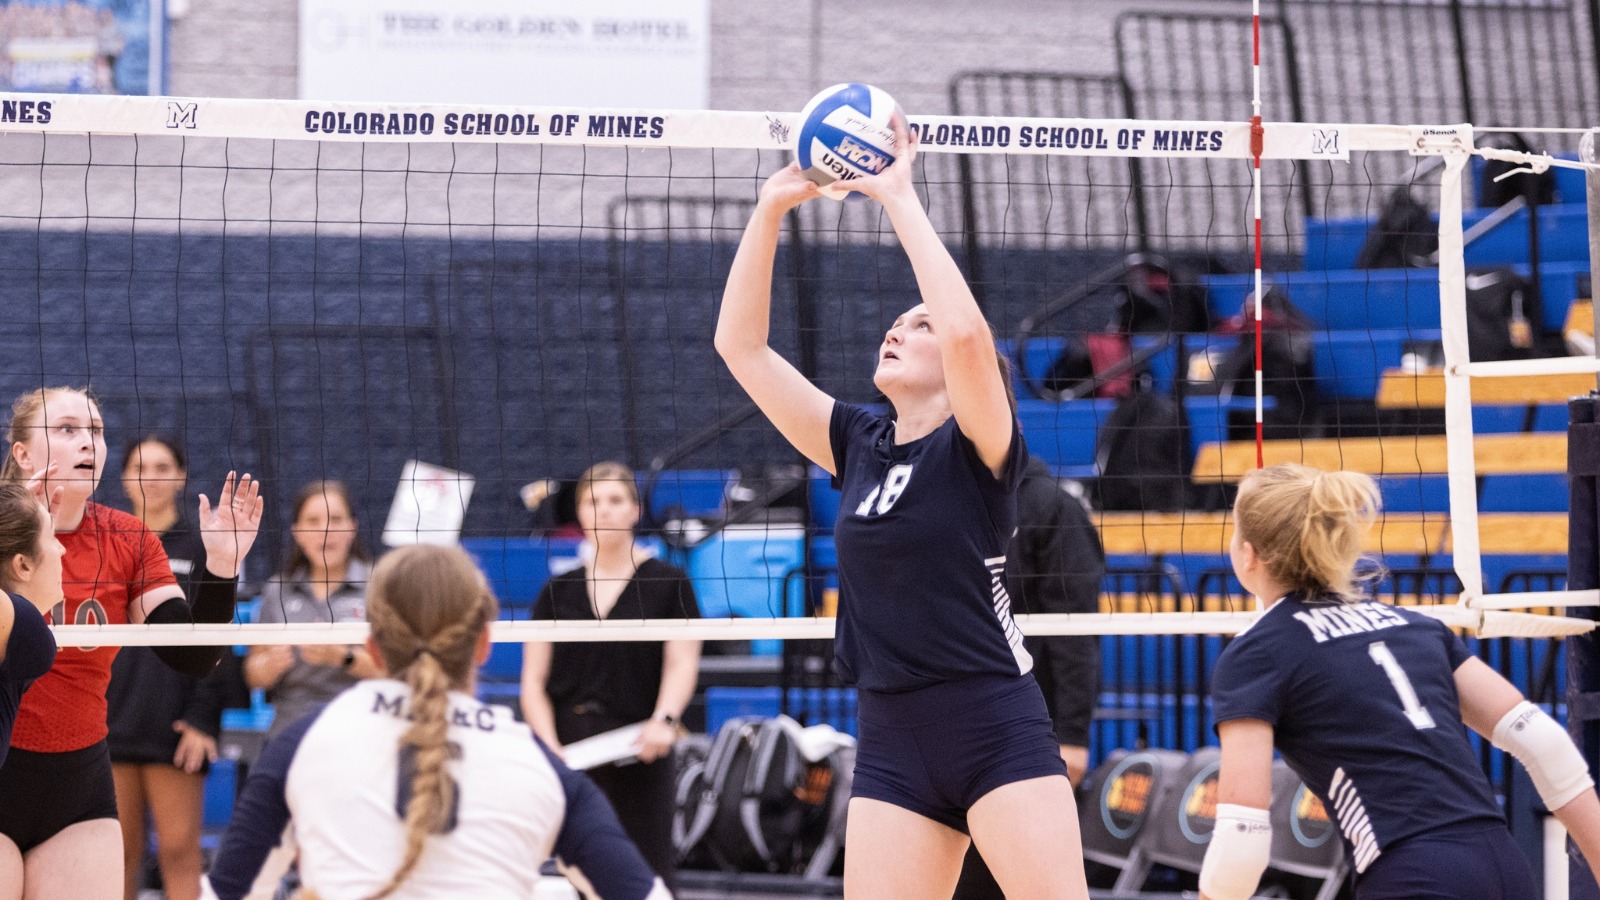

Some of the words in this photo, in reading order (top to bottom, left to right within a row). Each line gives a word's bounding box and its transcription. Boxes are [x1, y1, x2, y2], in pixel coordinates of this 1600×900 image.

[1, 100, 52, 124] NES
[167, 102, 198, 129] M
[305, 110, 435, 135] COLORADO
[444, 113, 540, 136] SCHOOL
[549, 115, 580, 137] OF
[587, 116, 664, 139] MINES
[909, 123, 1011, 148] LORADO
[1019, 126, 1108, 149] SCHOOL
[1117, 128, 1146, 150] OF
[1152, 129, 1223, 152] MINES
[1312, 129, 1339, 155] M
[822, 153, 864, 181] lten
[837, 137, 888, 173] NCAA
[855, 463, 914, 517] 18
[1291, 601, 1410, 643] MINES
[1367, 641, 1437, 730] 1
